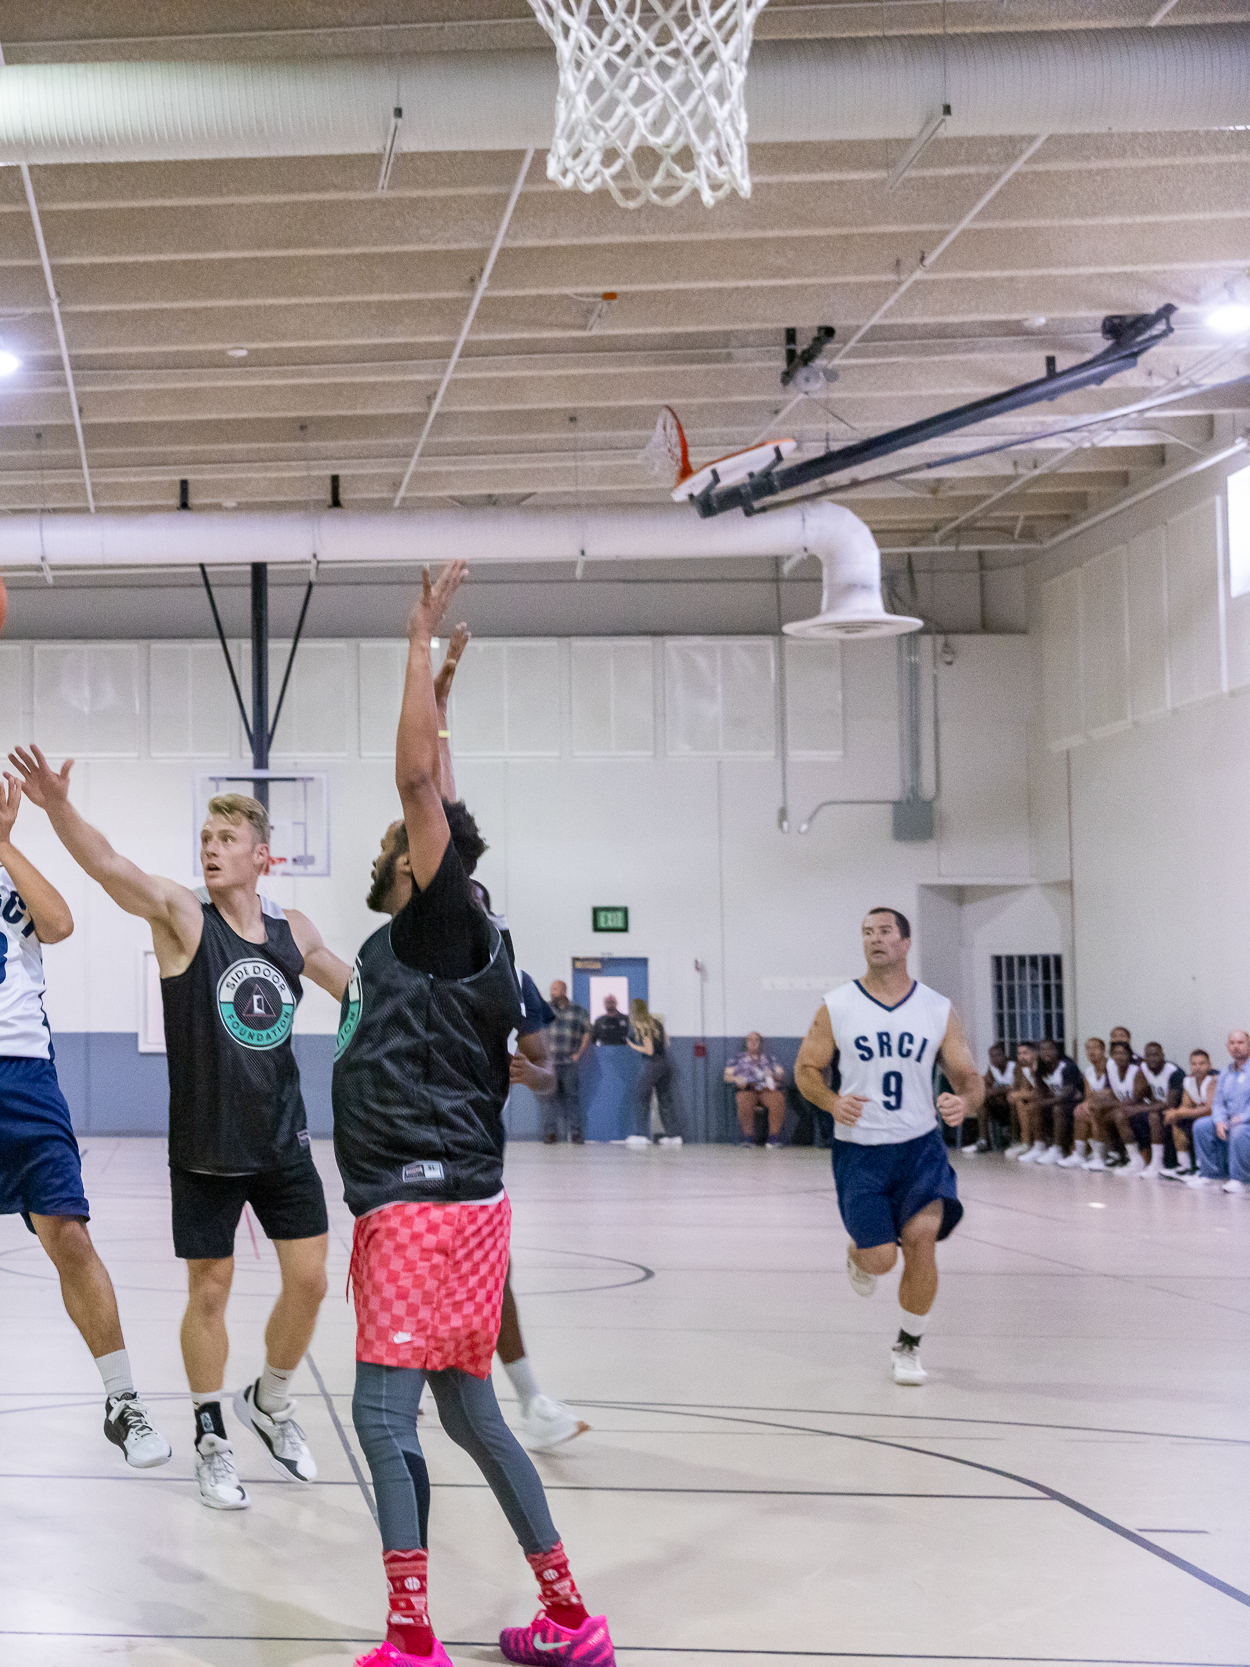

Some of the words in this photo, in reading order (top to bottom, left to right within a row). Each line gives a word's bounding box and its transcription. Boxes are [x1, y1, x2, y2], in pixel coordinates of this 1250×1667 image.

[225, 965, 250, 991] SIDE
[252, 965, 286, 993] DOOR
[226, 1011, 291, 1043] FOUNDATION
[854, 1031, 929, 1064] SRCI
[882, 1070, 904, 1112] 9
